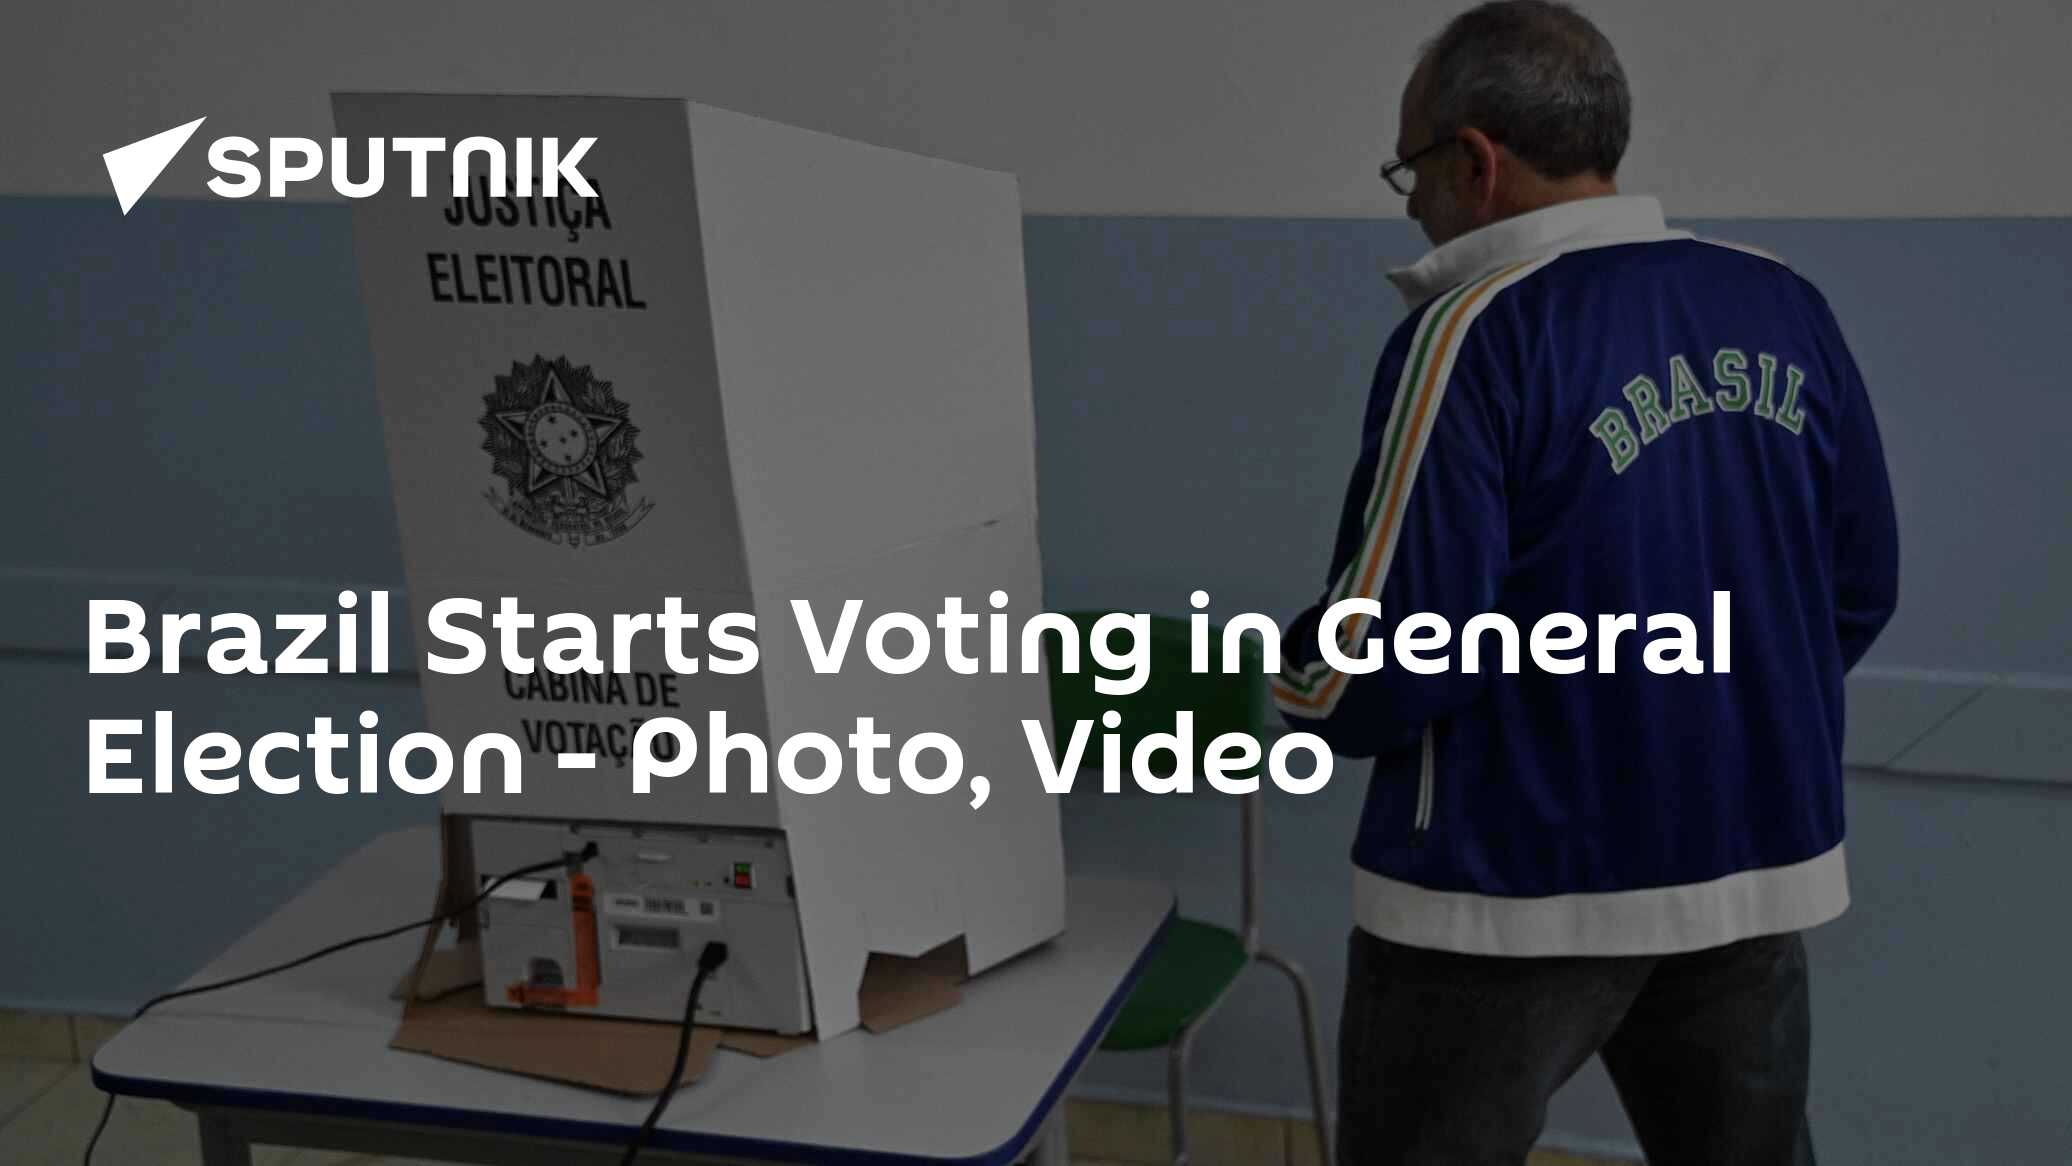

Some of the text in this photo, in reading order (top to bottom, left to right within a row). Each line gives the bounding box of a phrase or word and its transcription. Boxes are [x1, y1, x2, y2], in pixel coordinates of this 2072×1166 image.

[426, 252, 647, 310] ELEITORAL
[1589, 347, 1804, 475] BRASIL
[635, 671, 680, 708] DE
